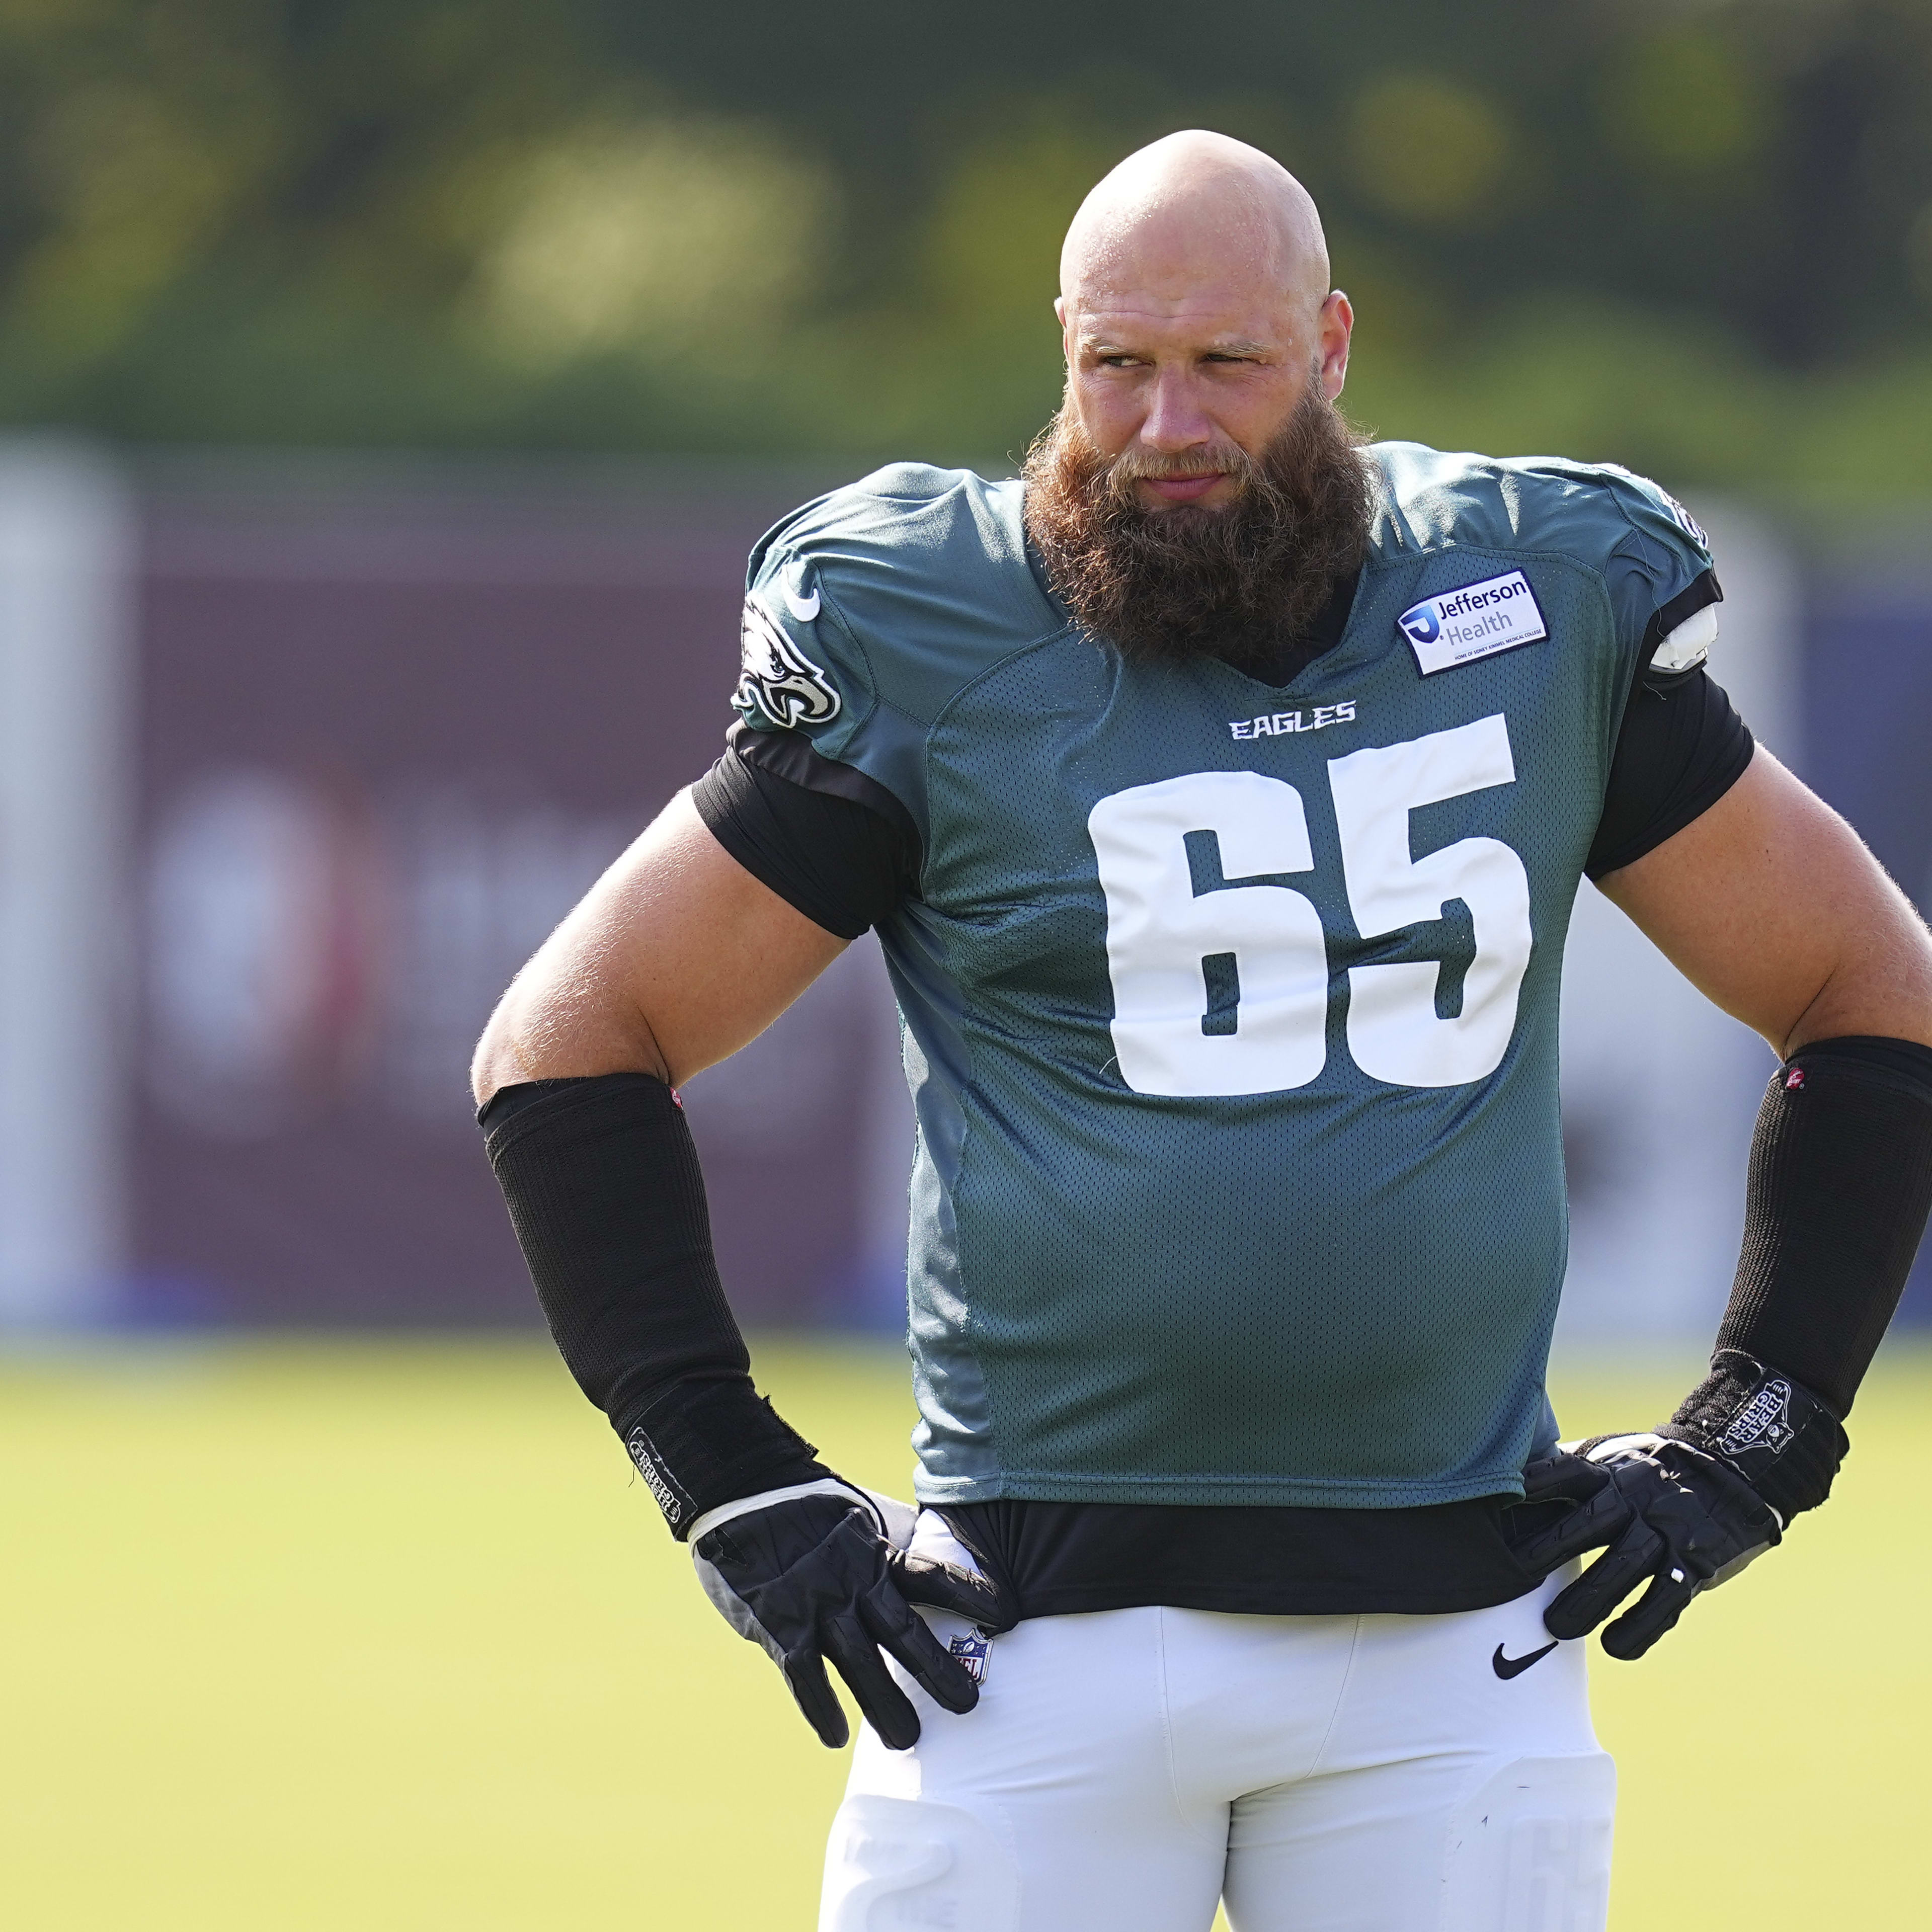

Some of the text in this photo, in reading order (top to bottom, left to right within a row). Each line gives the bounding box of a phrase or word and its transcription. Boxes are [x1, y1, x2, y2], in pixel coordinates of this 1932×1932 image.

[1438, 581, 1527, 620] Jefferson
[1446, 611, 1513, 646] Health
[1474, 646, 1488, 655] SIDNEY
[1488, 641, 1505, 650] KIMMEL
[1505, 634, 1524, 645] MEDICAL
[1524, 628, 1542, 637] COLLEGE
[1228, 699, 1356, 740] EAGLES
[1088, 712, 1533, 1097] 65
[1728, 1392, 1771, 1437] GRIPS
[1742, 1394, 1783, 1442] BEAR
[640, 1453, 674, 1503] GRIPS
[958, 1658, 979, 1678] FL
